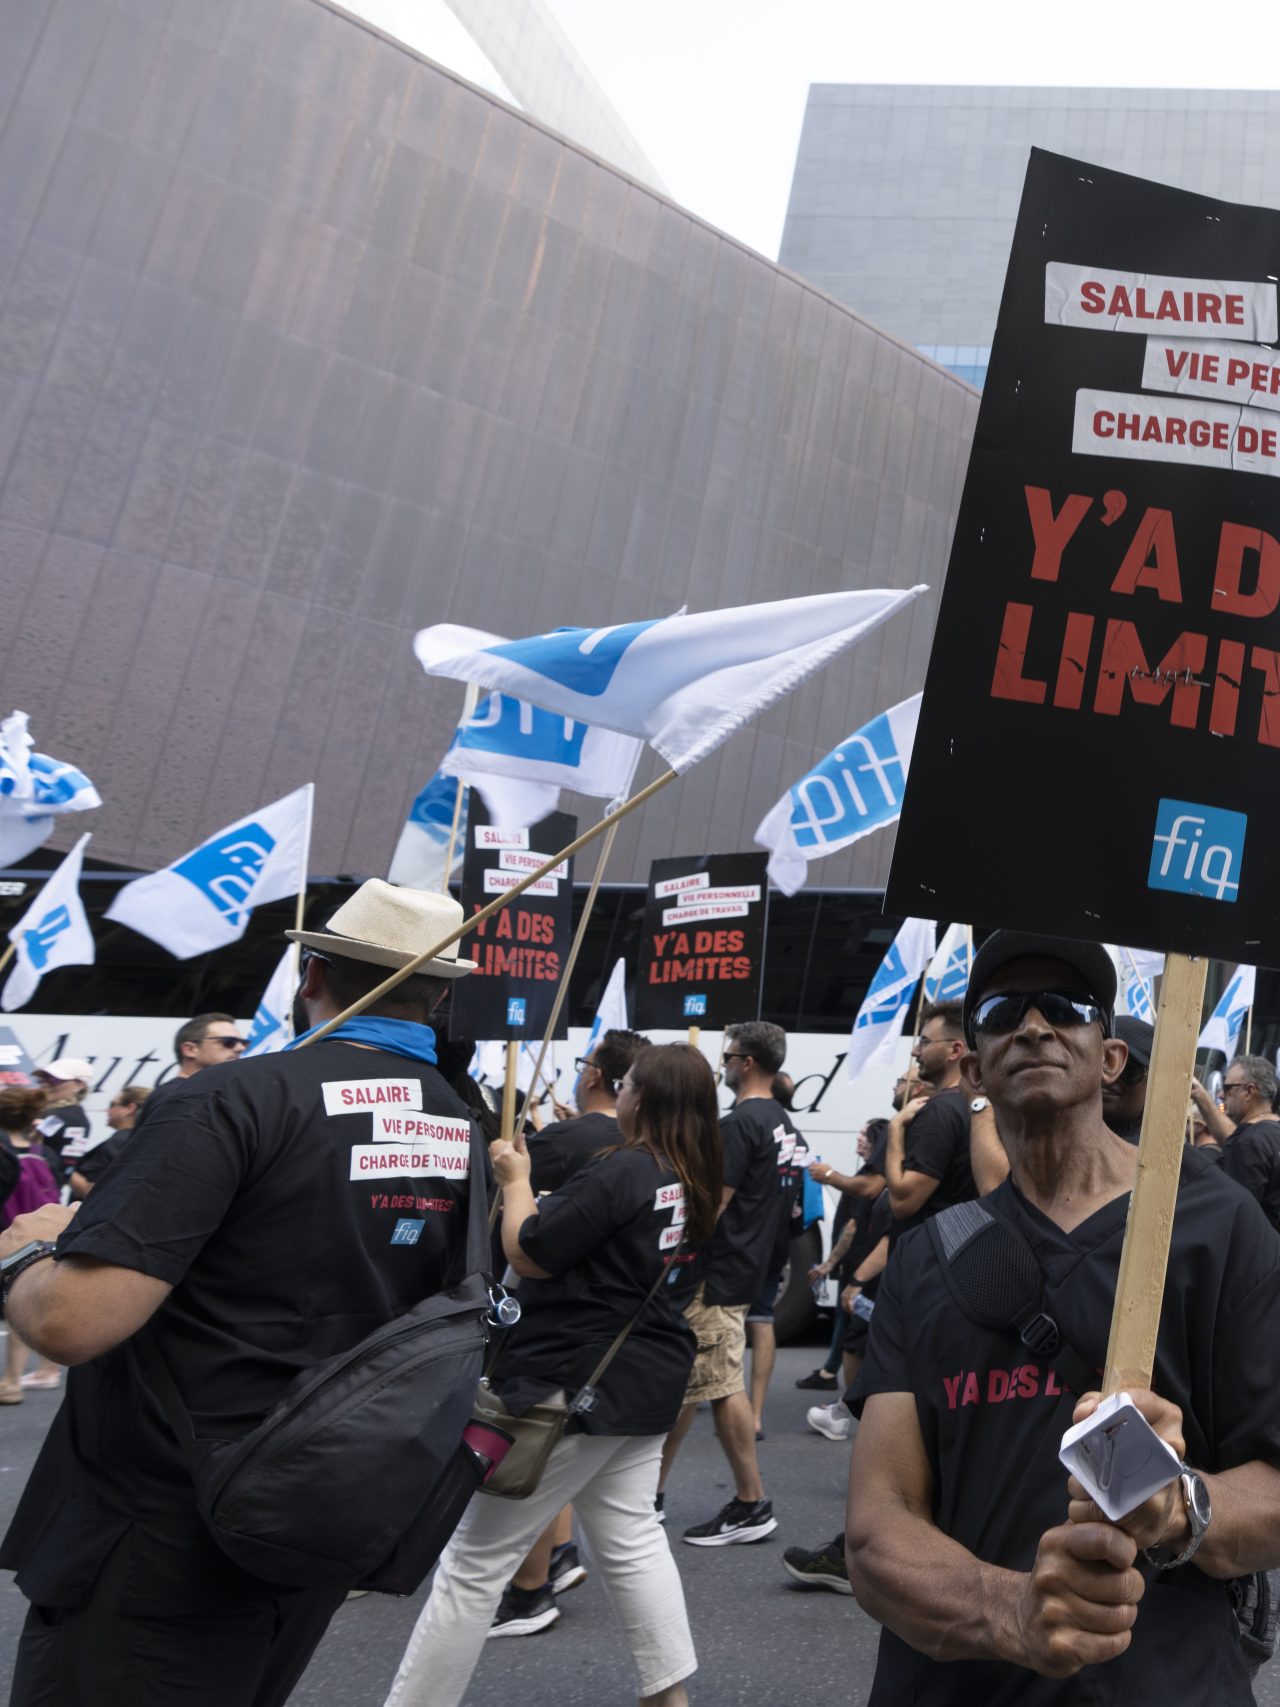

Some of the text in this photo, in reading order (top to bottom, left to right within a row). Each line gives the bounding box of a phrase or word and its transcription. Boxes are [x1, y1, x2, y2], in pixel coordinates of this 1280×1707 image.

[1080, 280, 1245, 327] SALAIRE
[1164, 349, 1219, 384] VIE
[1093, 410, 1229, 451] CHARGE
[1237, 426, 1277, 458] DE
[1024, 486, 1183, 603] Y'A
[1154, 814, 1239, 901] fiq
[664, 877, 701, 893] SALAIRE
[683, 890, 756, 902] VIE PERSONNELLE
[667, 905, 743, 921] CHARGE DE TRAVAIL
[517, 910, 555, 944] DES
[653, 930, 745, 957] Y'A DES
[471, 943, 560, 981] LIMITES
[649, 956, 752, 985] LIMITES
[507, 1001, 526, 1025] fiq
[684, 997, 706, 1015] fiq
[341, 1086, 411, 1106] SALAIRE
[382, 1118, 402, 1134] VIE
[359, 1154, 409, 1170] CHARGE
[411, 1154, 430, 1168] DE
[370, 1194, 454, 1212] Y'A DES LIMITES
[394, 1222, 419, 1245] fiq
[986, 1364, 1040, 1403] DES
